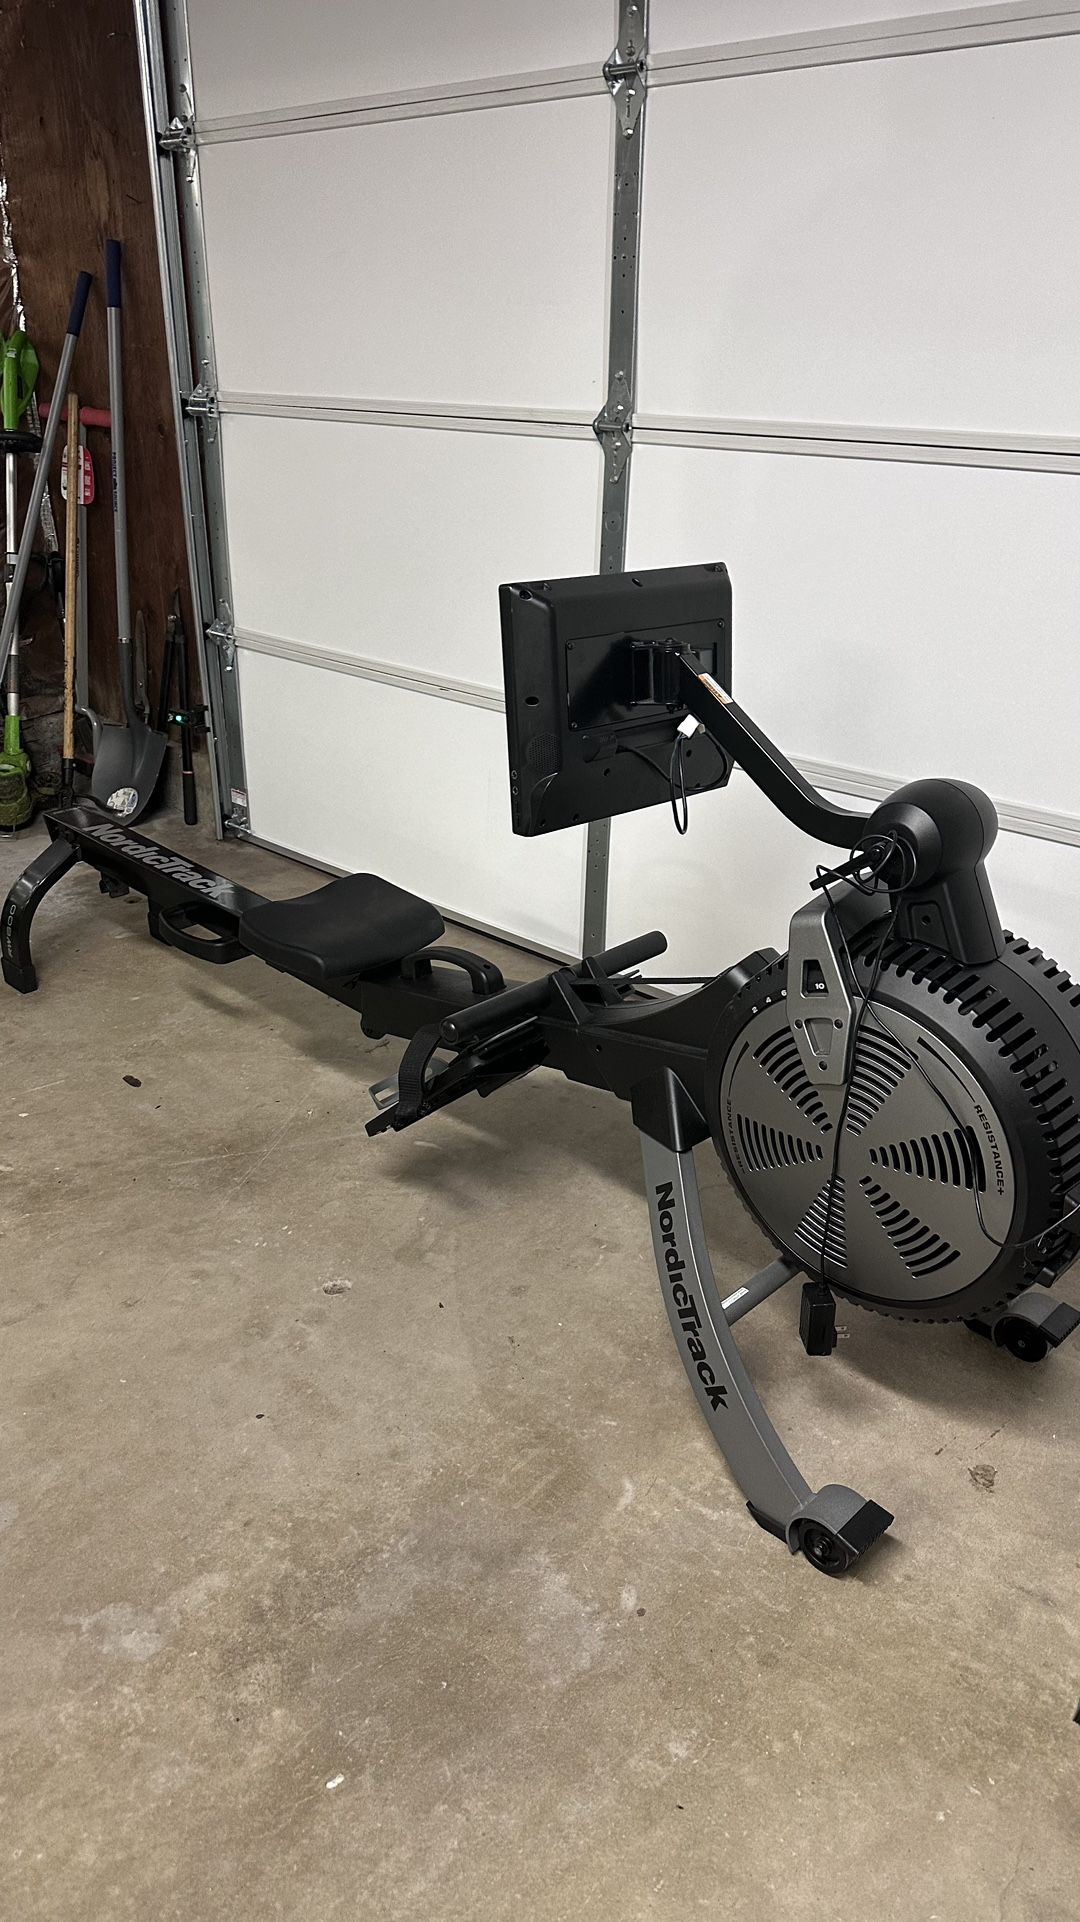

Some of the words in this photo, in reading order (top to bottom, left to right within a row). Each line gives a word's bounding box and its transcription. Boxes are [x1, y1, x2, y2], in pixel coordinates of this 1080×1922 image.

[82, 823, 236, 899] NordicTrack
[751, 1006, 759, 1014] 2
[974, 1104, 1005, 1196] RESISTANCE+
[655, 1180, 729, 1412] NordicTrack
